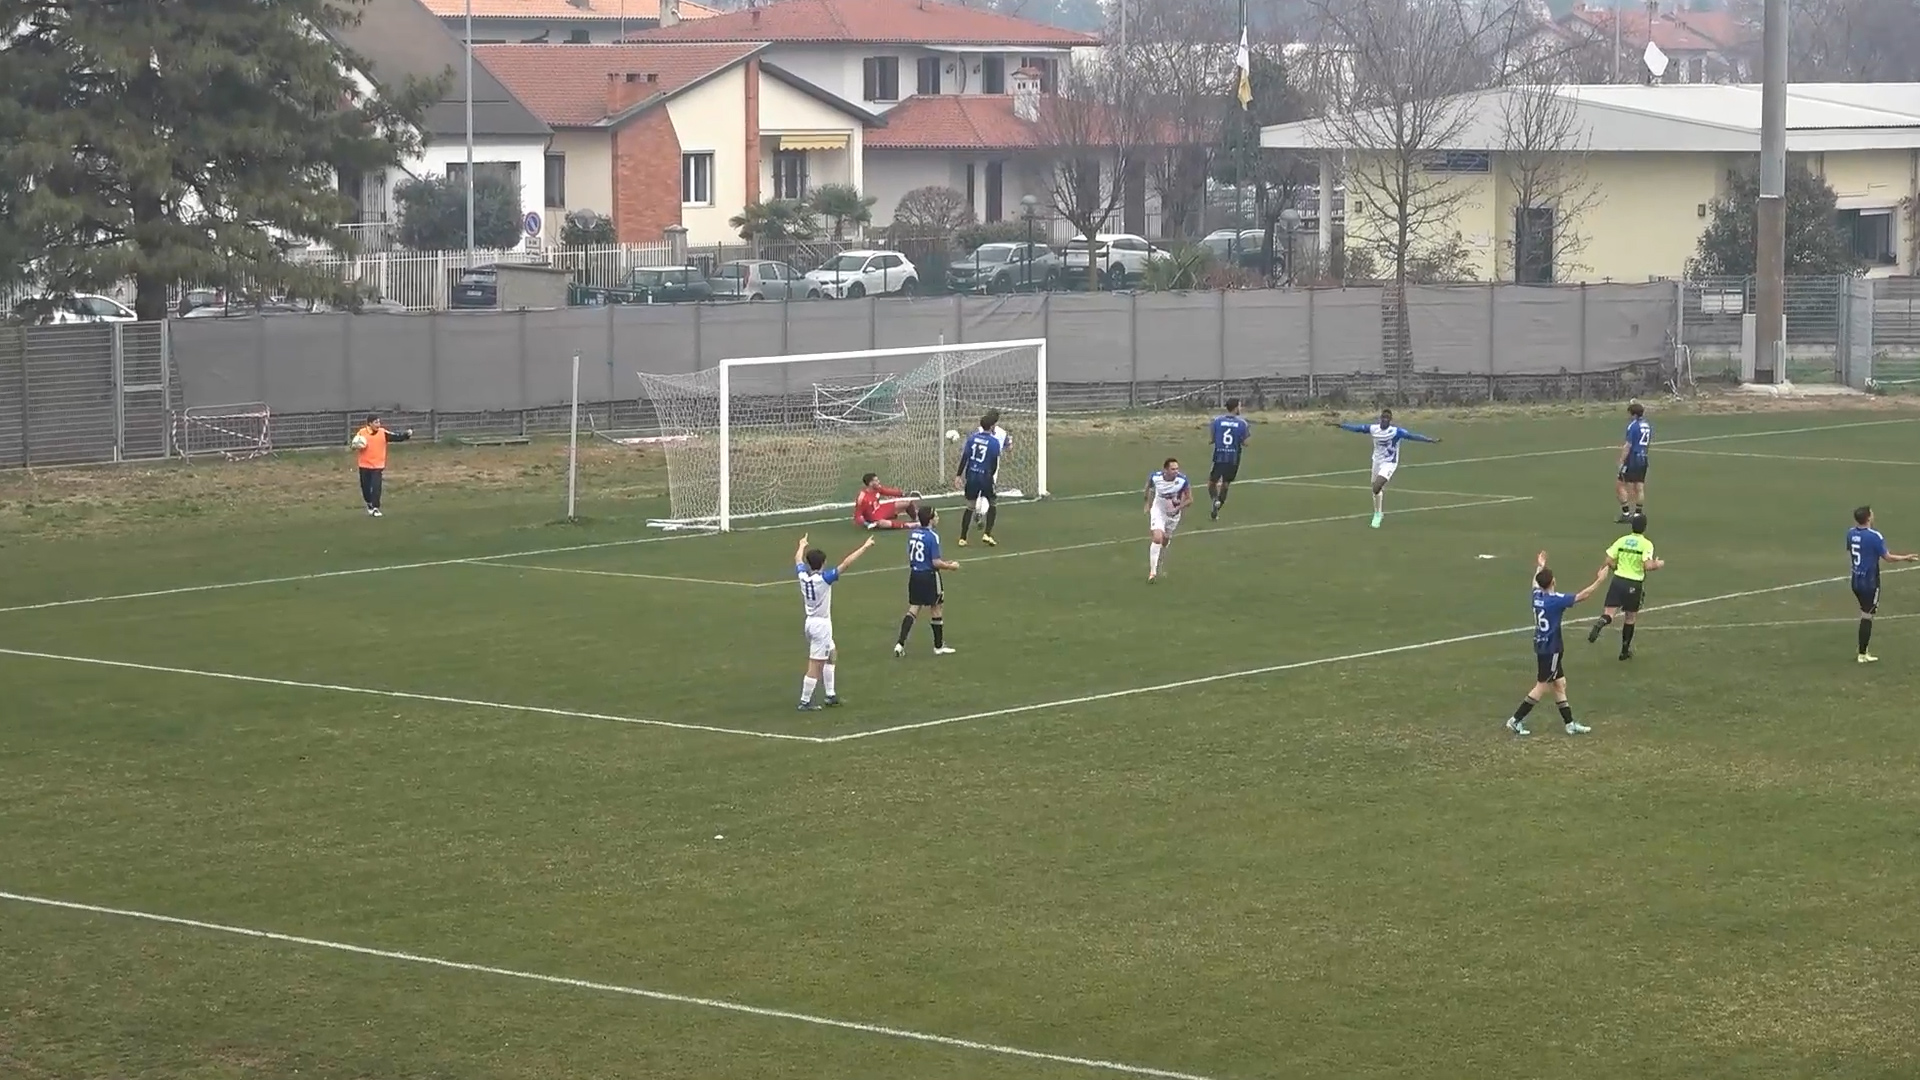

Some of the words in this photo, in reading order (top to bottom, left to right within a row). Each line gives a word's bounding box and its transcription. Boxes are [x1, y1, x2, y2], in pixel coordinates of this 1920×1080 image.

[1222, 427, 1233, 445] 6
[970, 443, 988, 463] 13
[909, 539, 925, 562] 78
[1850, 543, 1861, 566] 5
[801, 579, 816, 601] 11
